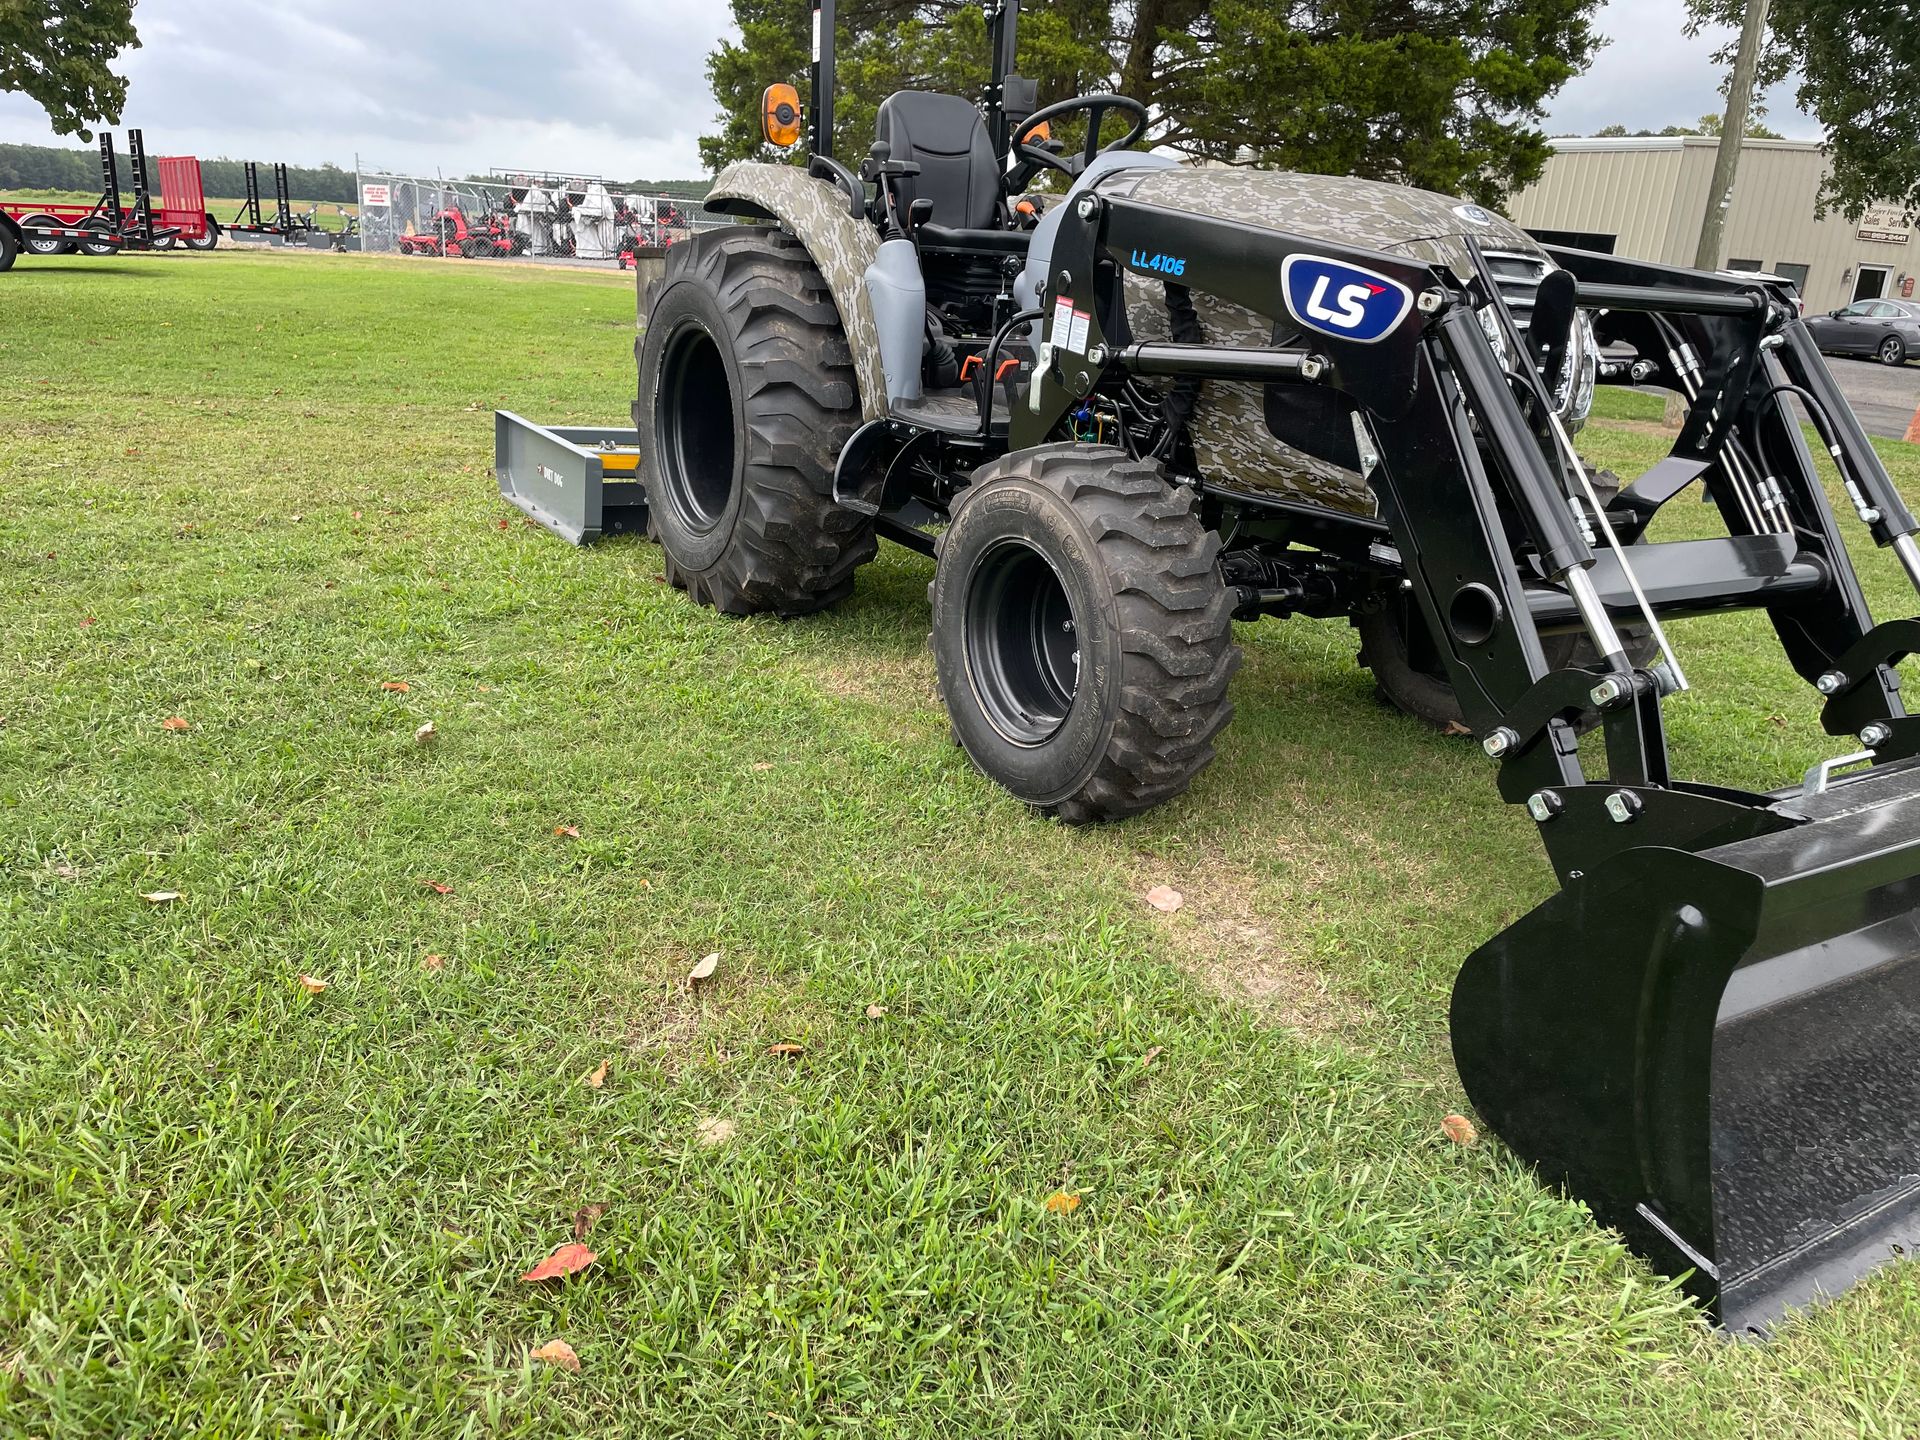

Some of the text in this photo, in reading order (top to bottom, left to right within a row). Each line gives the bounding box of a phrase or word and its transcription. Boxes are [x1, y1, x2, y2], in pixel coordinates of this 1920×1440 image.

[1864, 215, 1880, 225] Sales
[1131, 249, 1186, 276] LL4106
[1306, 275, 1371, 328] LS
